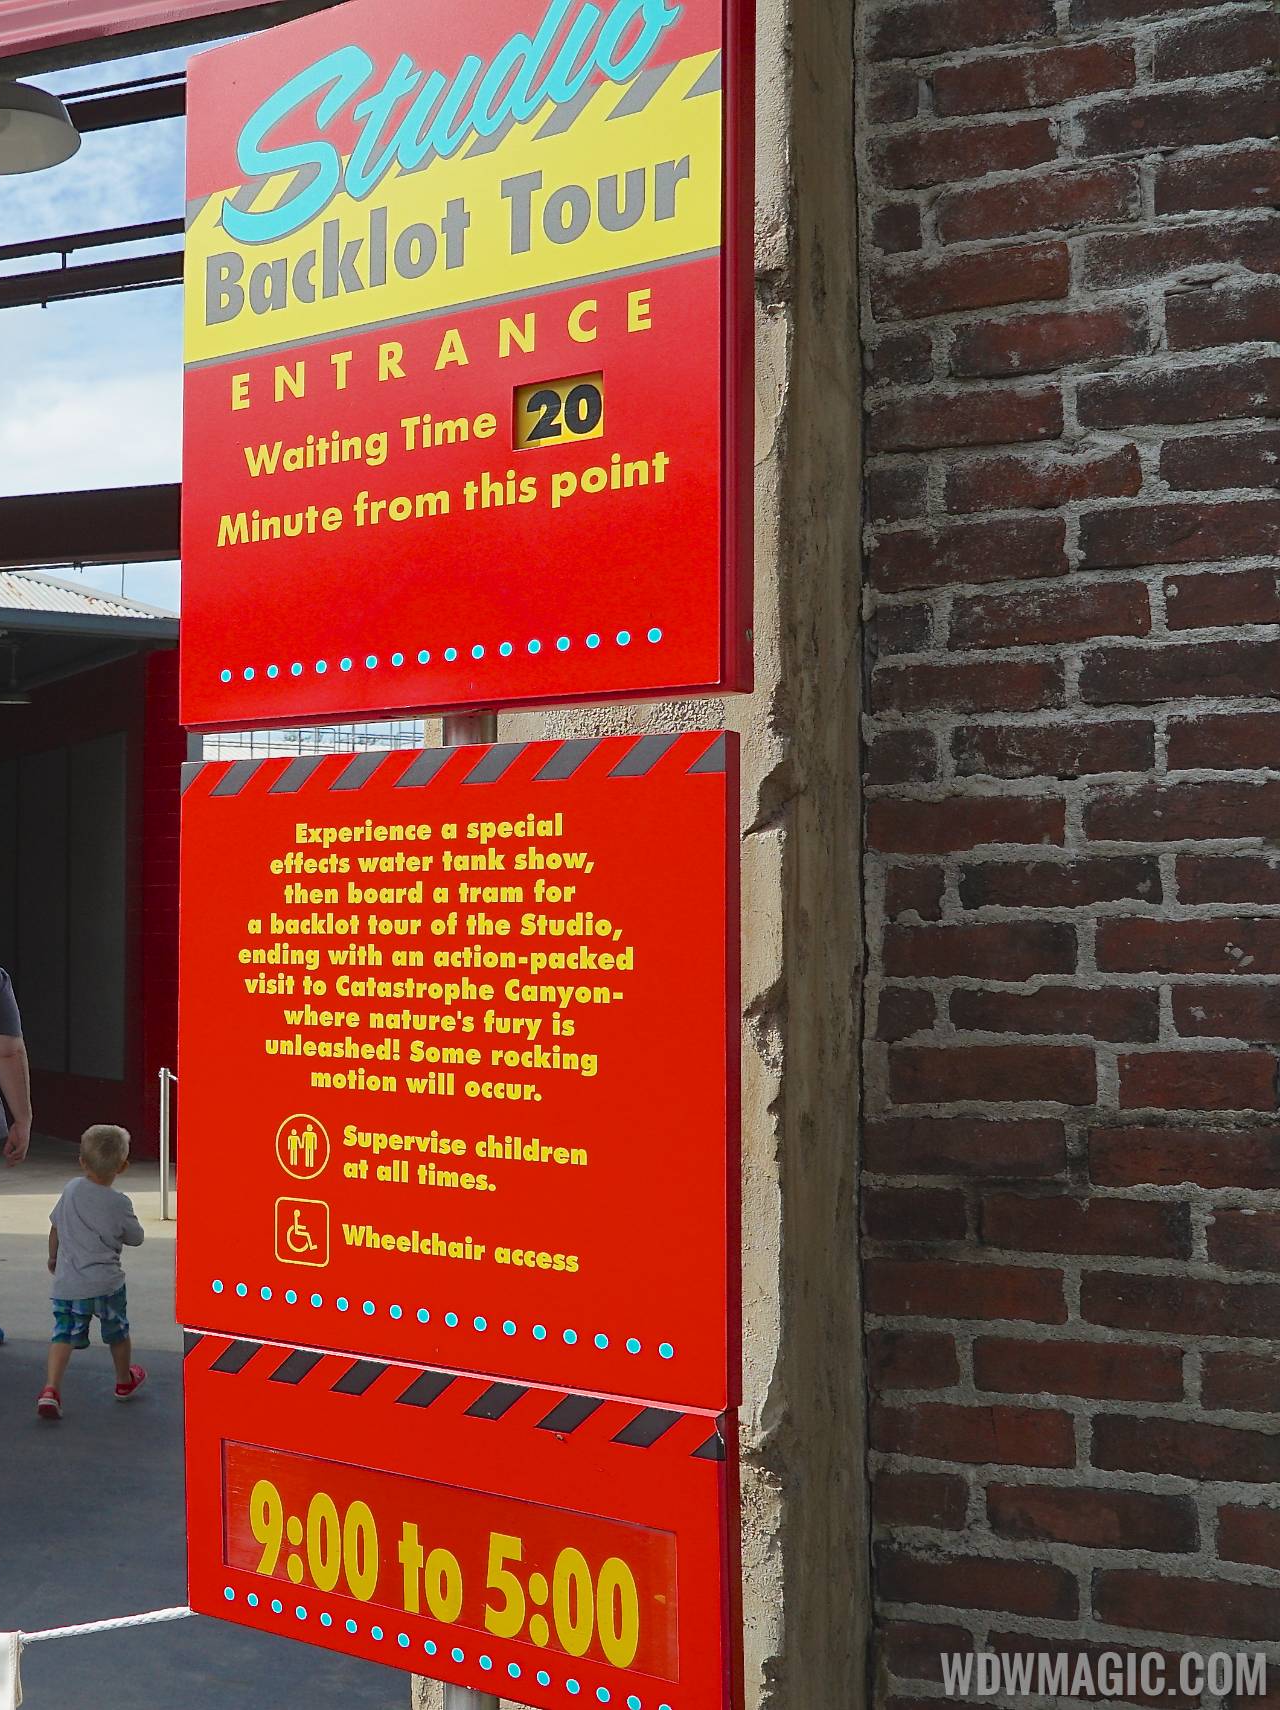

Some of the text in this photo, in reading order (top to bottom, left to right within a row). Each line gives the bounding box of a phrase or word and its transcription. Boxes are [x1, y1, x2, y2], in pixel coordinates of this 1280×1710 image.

[222, 0, 681, 245] Studio
[205, 155, 690, 326] Backlot Tour
[231, 289, 653, 411] ENTRANCE
[244, 383, 602, 478] Waiting Time 20
[217, 451, 670, 548] Minute from this point
[295, 813, 563, 848] Experience a special
[270, 847, 594, 875] effects water tank show,
[284, 879, 575, 904] then board a tram for
[248, 912, 623, 941] a backlot tour of the Studio,
[238, 942, 634, 974] ending with an action-packed
[244, 973, 623, 1009] visit to Catastrophe Canyon-
[284, 1004, 575, 1040] where nature's fury is
[265, 1034, 598, 1076] unleashed! Some rocking
[311, 1069, 542, 1101] motion will occur.
[343, 1125, 588, 1166] Supervise children
[343, 1159, 496, 1191] at all times.
[342, 1224, 579, 1273] Wheelchair access
[249, 1479, 639, 1669] 9:00 to 5:00
